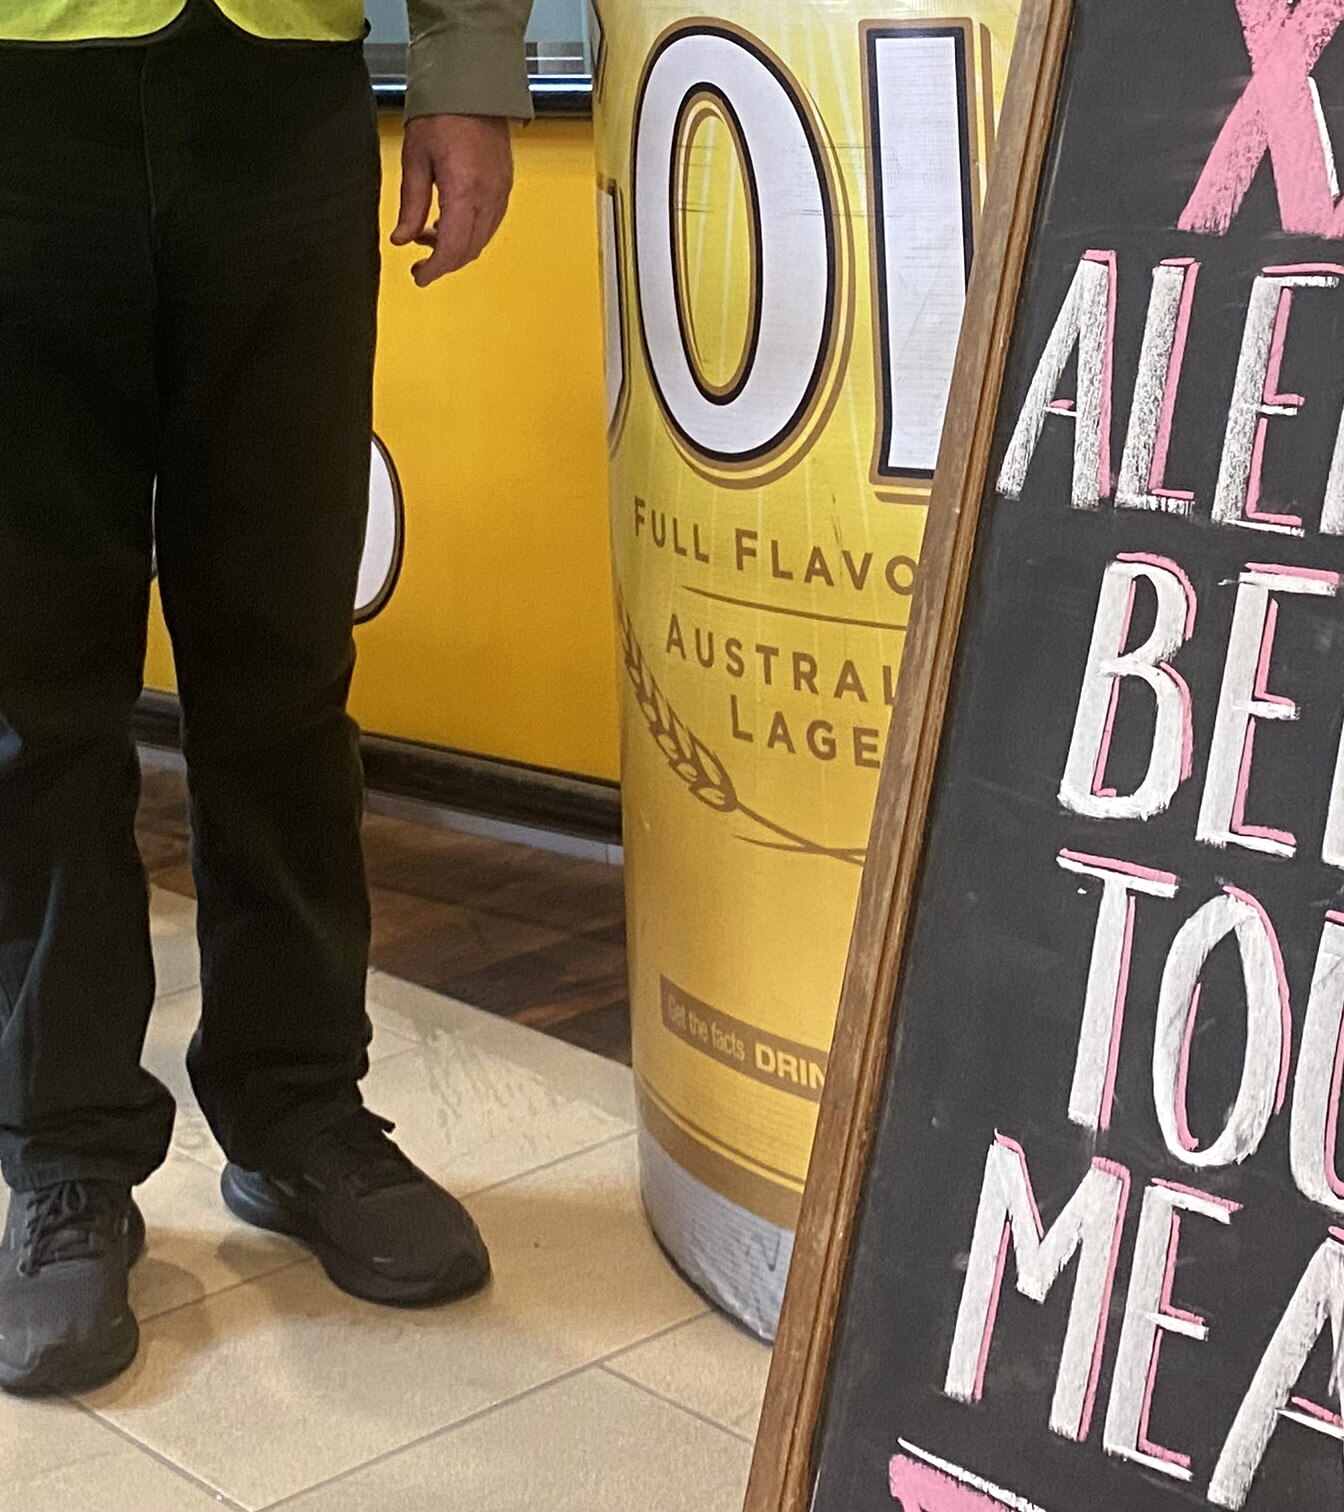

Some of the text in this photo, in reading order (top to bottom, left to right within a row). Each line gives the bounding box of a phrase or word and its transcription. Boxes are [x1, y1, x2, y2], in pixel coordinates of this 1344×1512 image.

[634, 495, 917, 596] FULL FLAVO
[666, 612, 895, 707] AUSTRAL
[730, 694, 882, 770] LAGE
[688, 1010, 708, 1038] the
[710, 1021, 746, 1061] facts
[755, 1043, 826, 1089] DRIN
